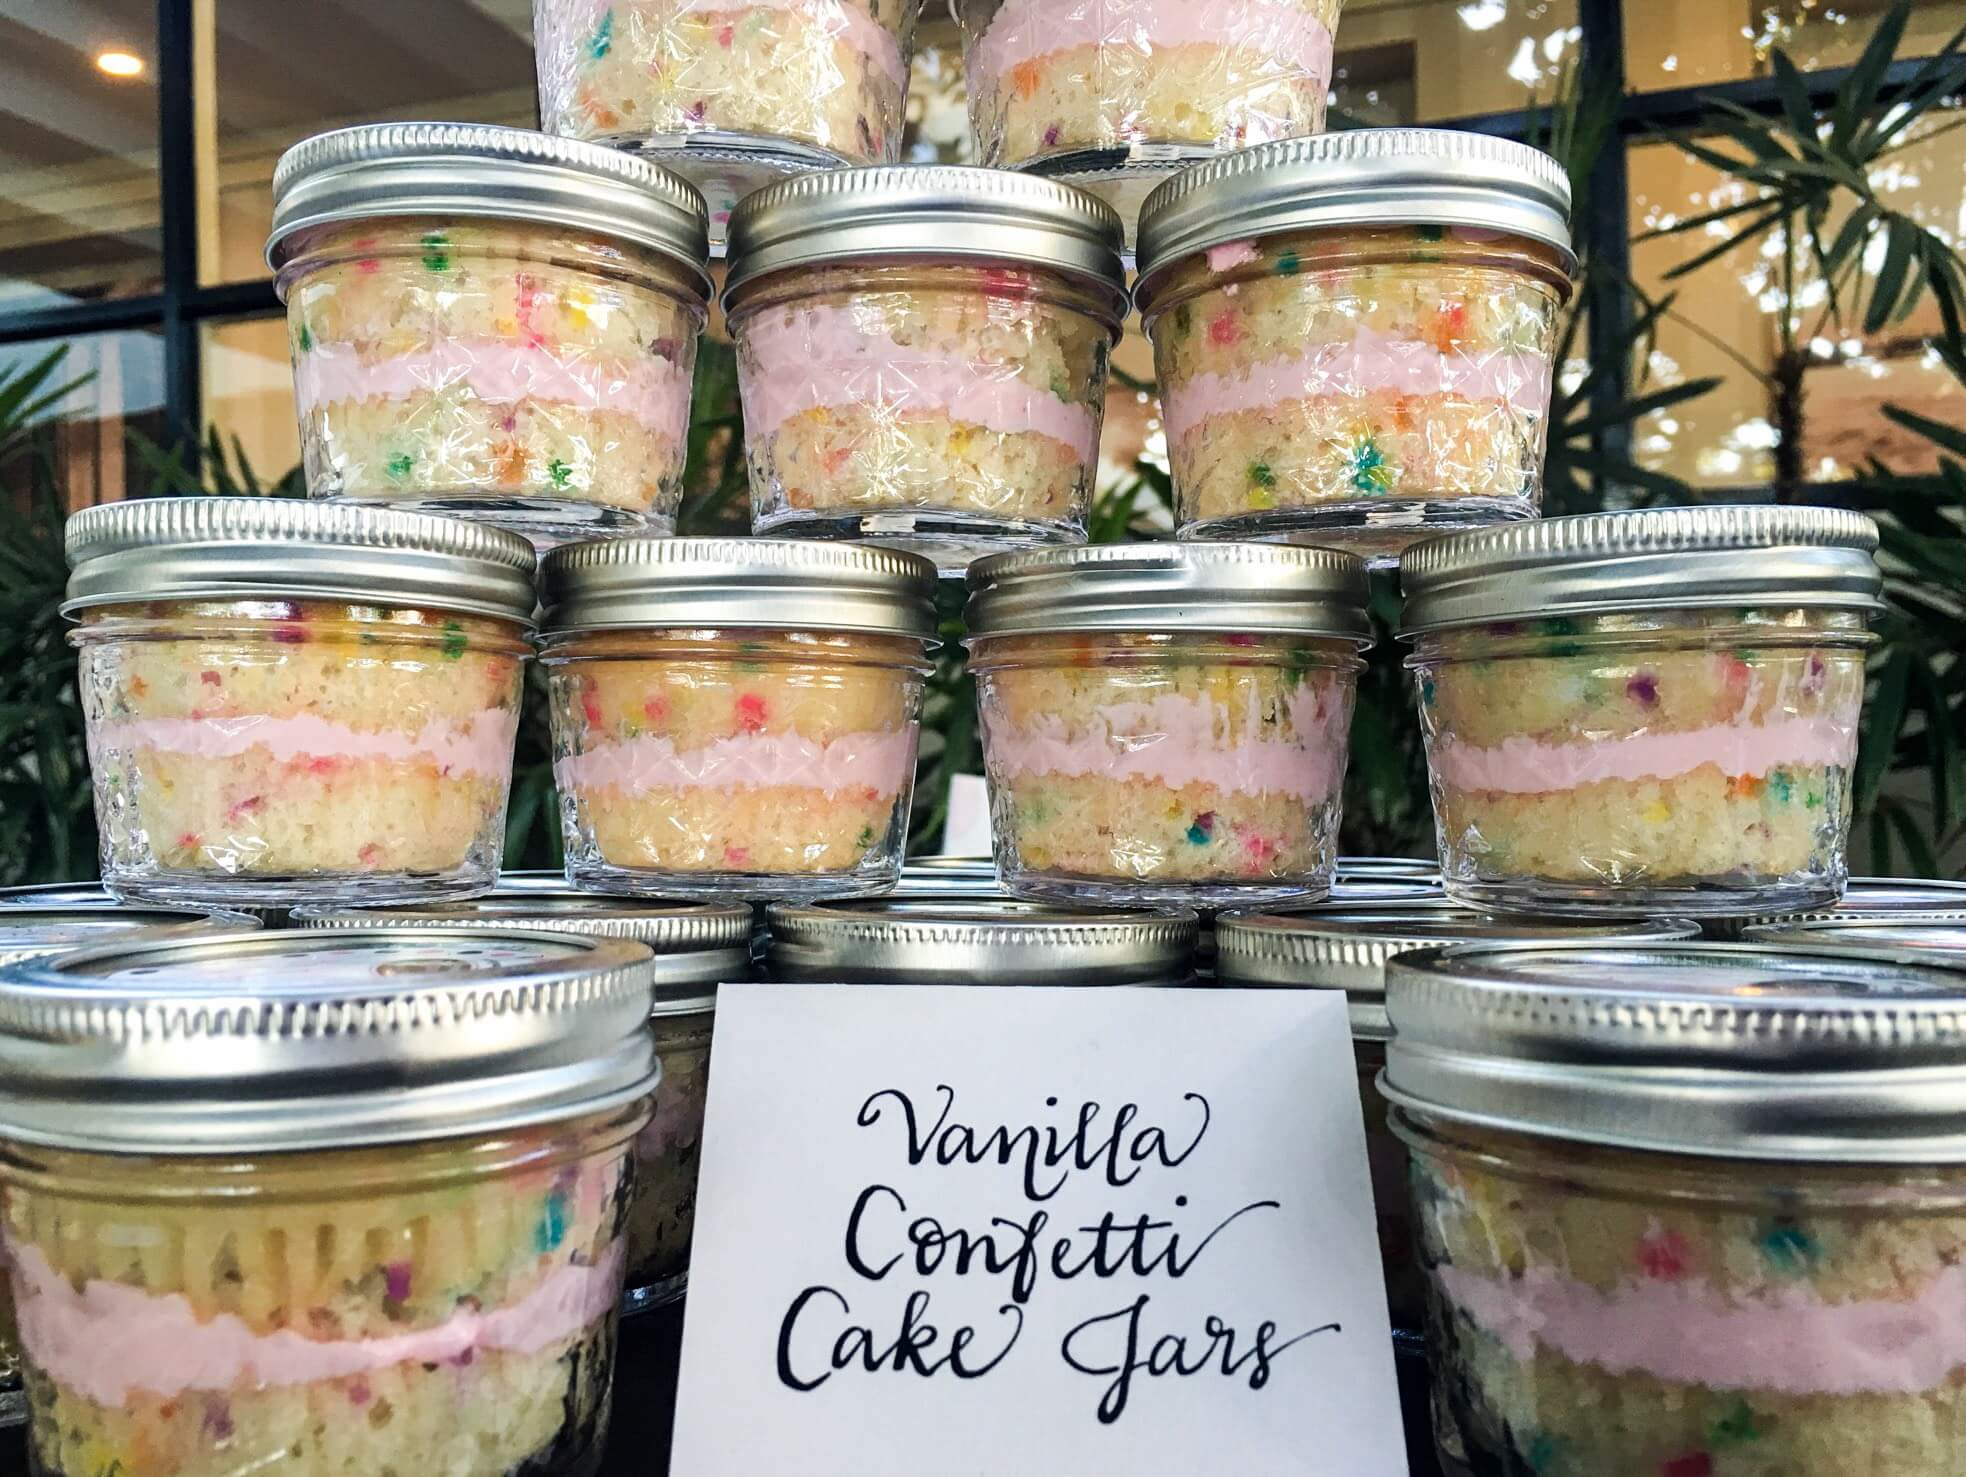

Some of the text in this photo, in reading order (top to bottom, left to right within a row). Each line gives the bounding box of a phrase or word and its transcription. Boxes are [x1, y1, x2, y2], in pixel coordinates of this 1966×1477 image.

[857, 1085, 1211, 1202] Vanilla
[845, 1185, 1281, 1304] Confetti
[776, 1286, 1342, 1425] Cake Jars
